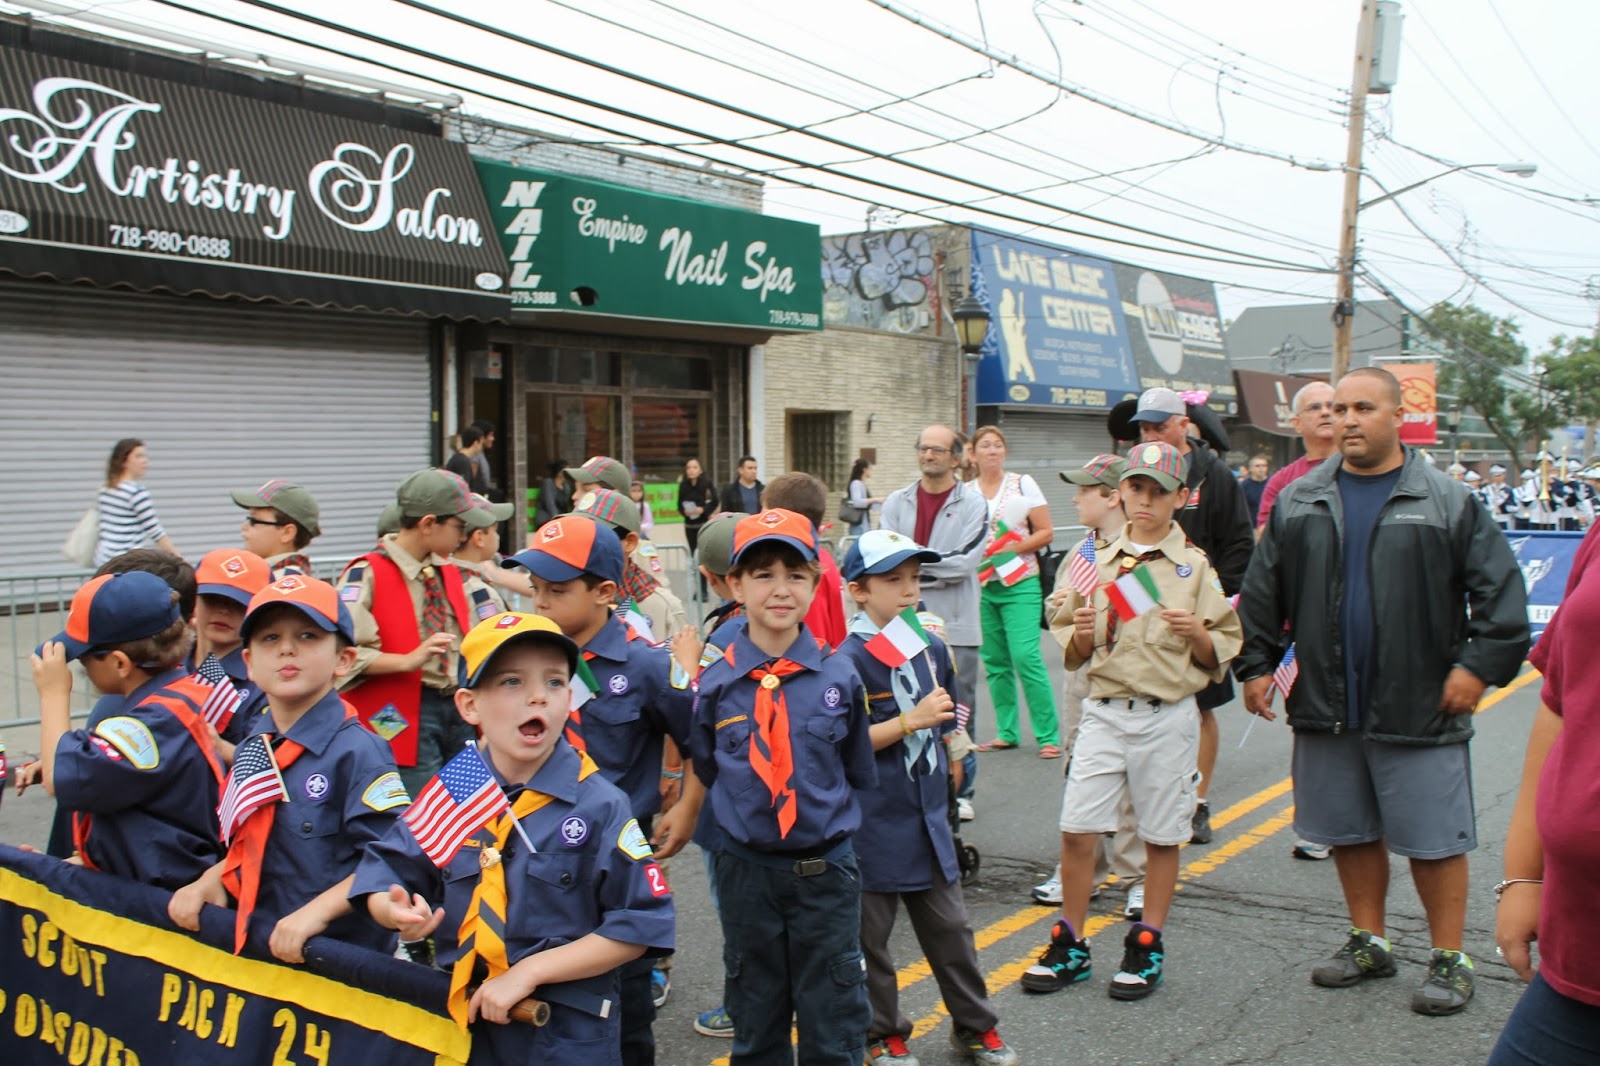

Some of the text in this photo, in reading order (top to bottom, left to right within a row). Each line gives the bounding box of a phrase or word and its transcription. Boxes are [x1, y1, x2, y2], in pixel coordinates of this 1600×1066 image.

[0, 77, 483, 247] Artistry Salon
[109, 225, 231, 259] 718-980-0888
[501, 181, 546, 289] NAIL
[572, 197, 648, 253] Empire
[659, 227, 728, 285] Nail
[741, 241, 796, 303] Spa
[648, 868, 665, 892] 2
[157, 973, 246, 1048] PACK
